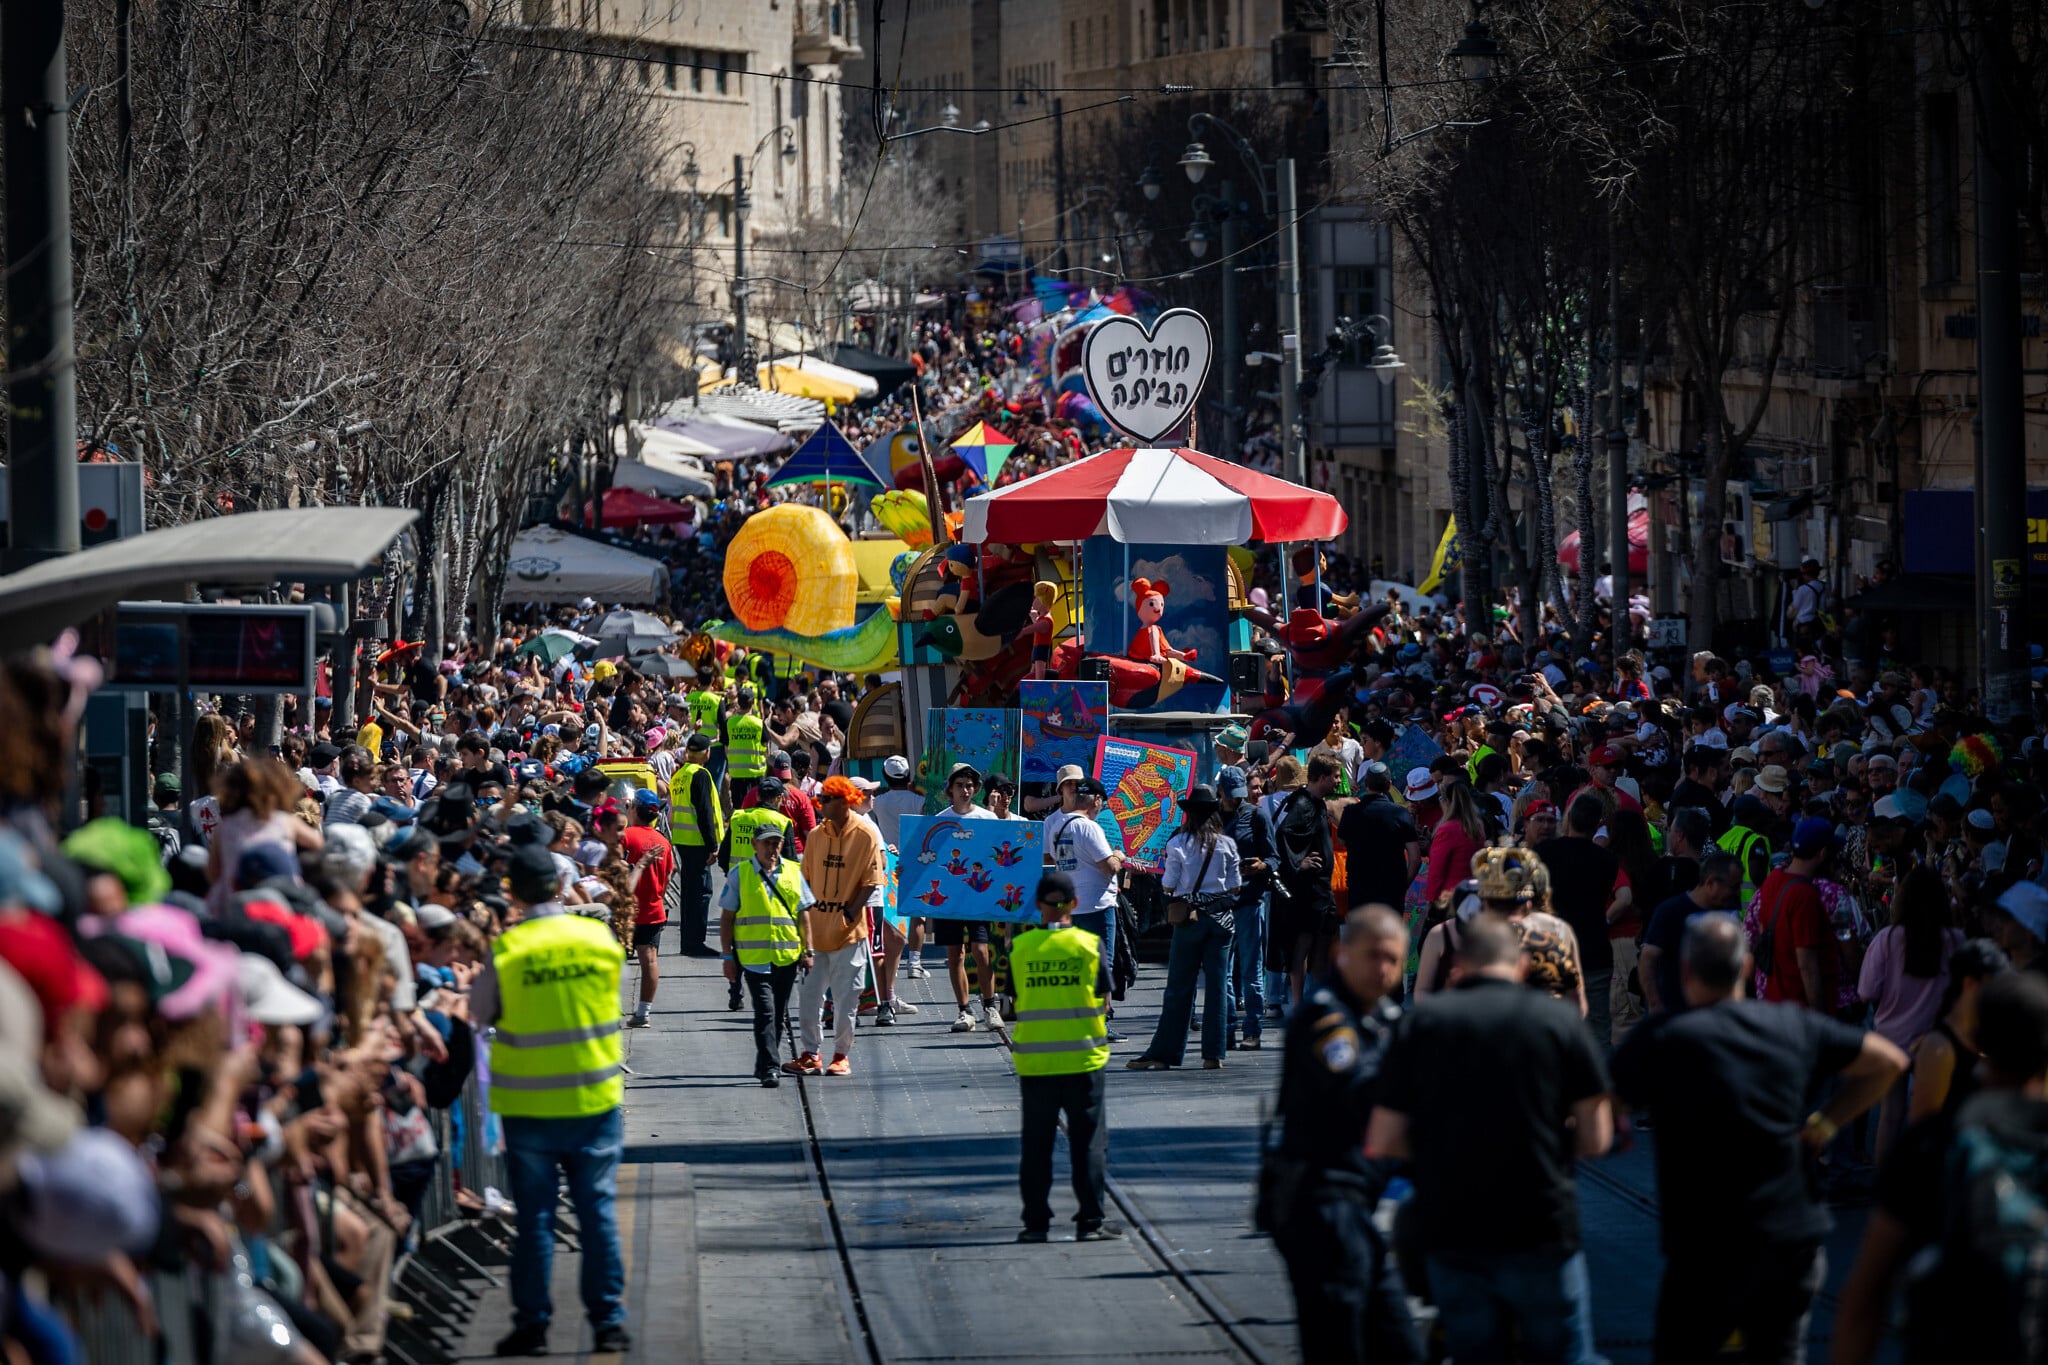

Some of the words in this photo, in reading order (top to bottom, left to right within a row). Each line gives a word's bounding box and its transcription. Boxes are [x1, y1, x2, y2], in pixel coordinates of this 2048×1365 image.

[1107, 345, 1190, 379] חוזרים
[1111, 377, 1188, 408] הביתה
[738, 825, 755, 833] יקוד
[1026, 975, 1080, 987] אבטחה
